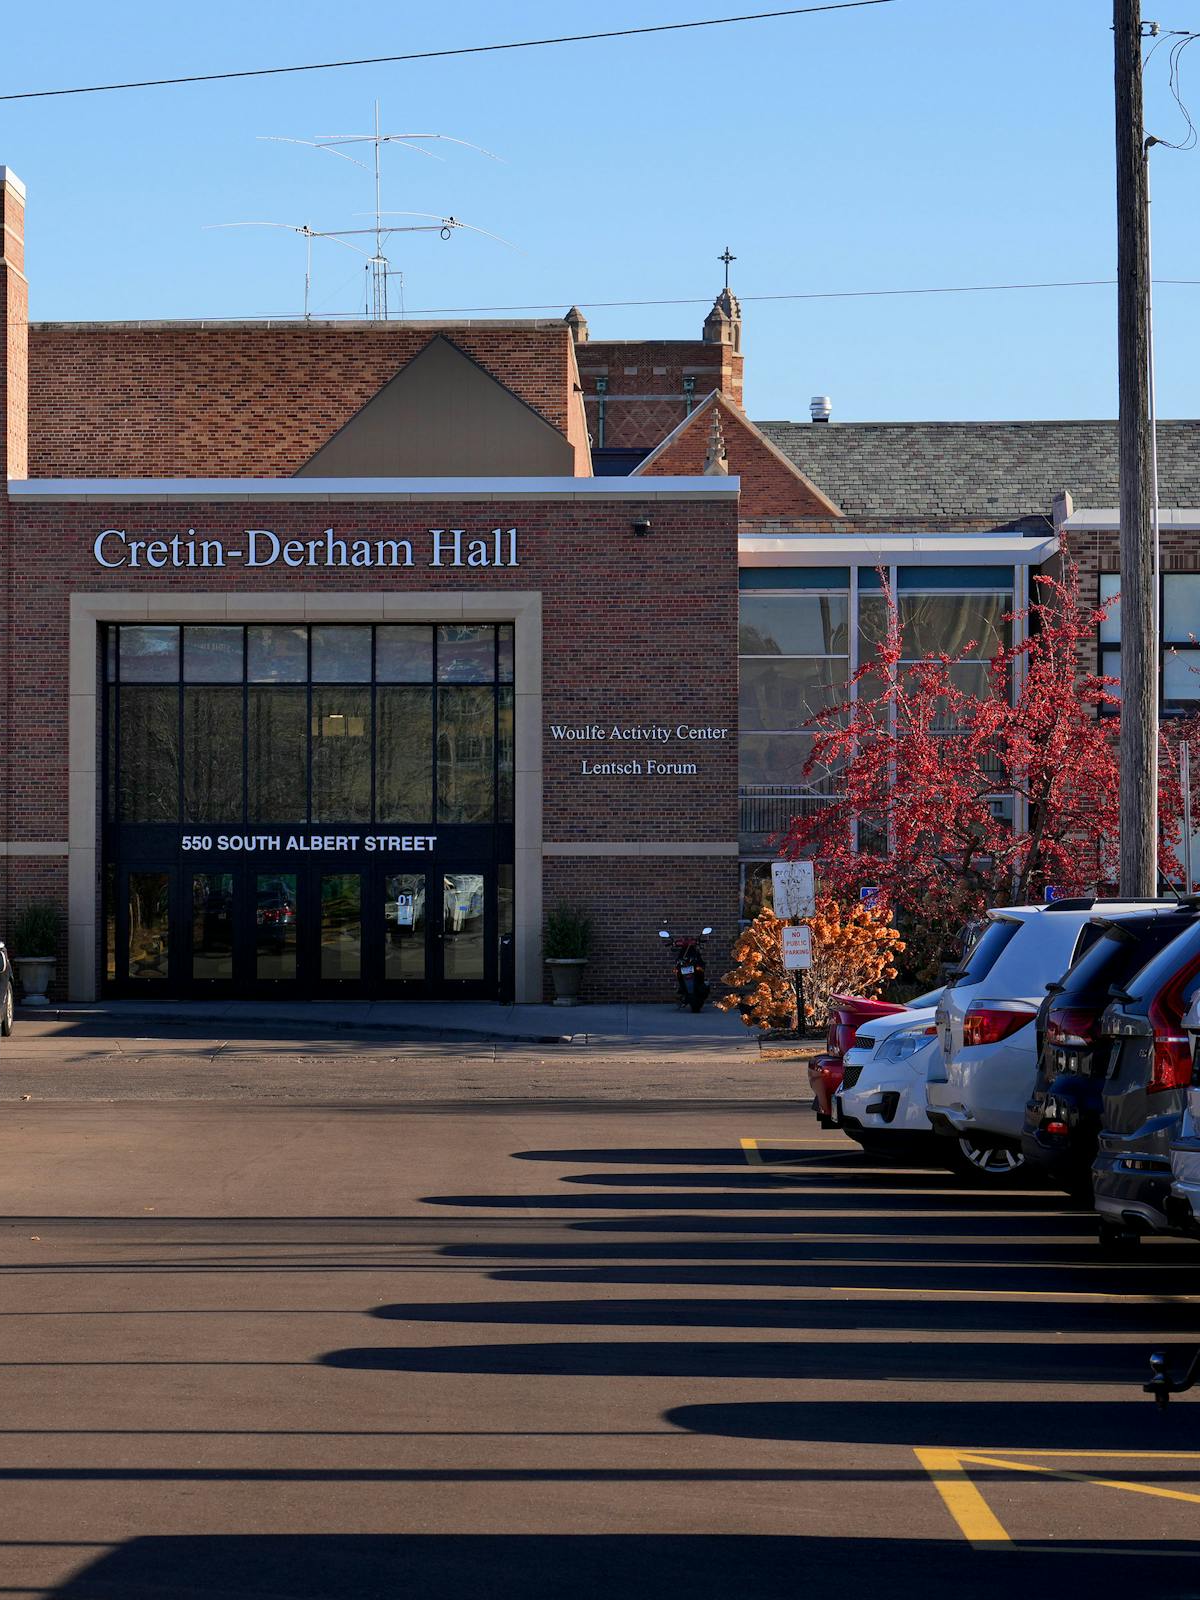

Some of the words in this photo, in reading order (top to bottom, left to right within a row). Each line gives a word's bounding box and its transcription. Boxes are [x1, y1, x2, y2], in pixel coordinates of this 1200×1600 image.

[93, 528, 415, 568] Cretin-Derham
[428, 528, 520, 567] Hall
[550, 725, 605, 740] Woulfe
[610, 725, 671, 743] Activity
[676, 724, 728, 740] Center
[581, 760, 641, 775] Lentsch
[647, 760, 697, 775] Forum
[181, 836, 212, 850] 550
[217, 836, 281, 850] SOUTH
[285, 836, 360, 850] ALBERT
[364, 836, 437, 851] STREET
